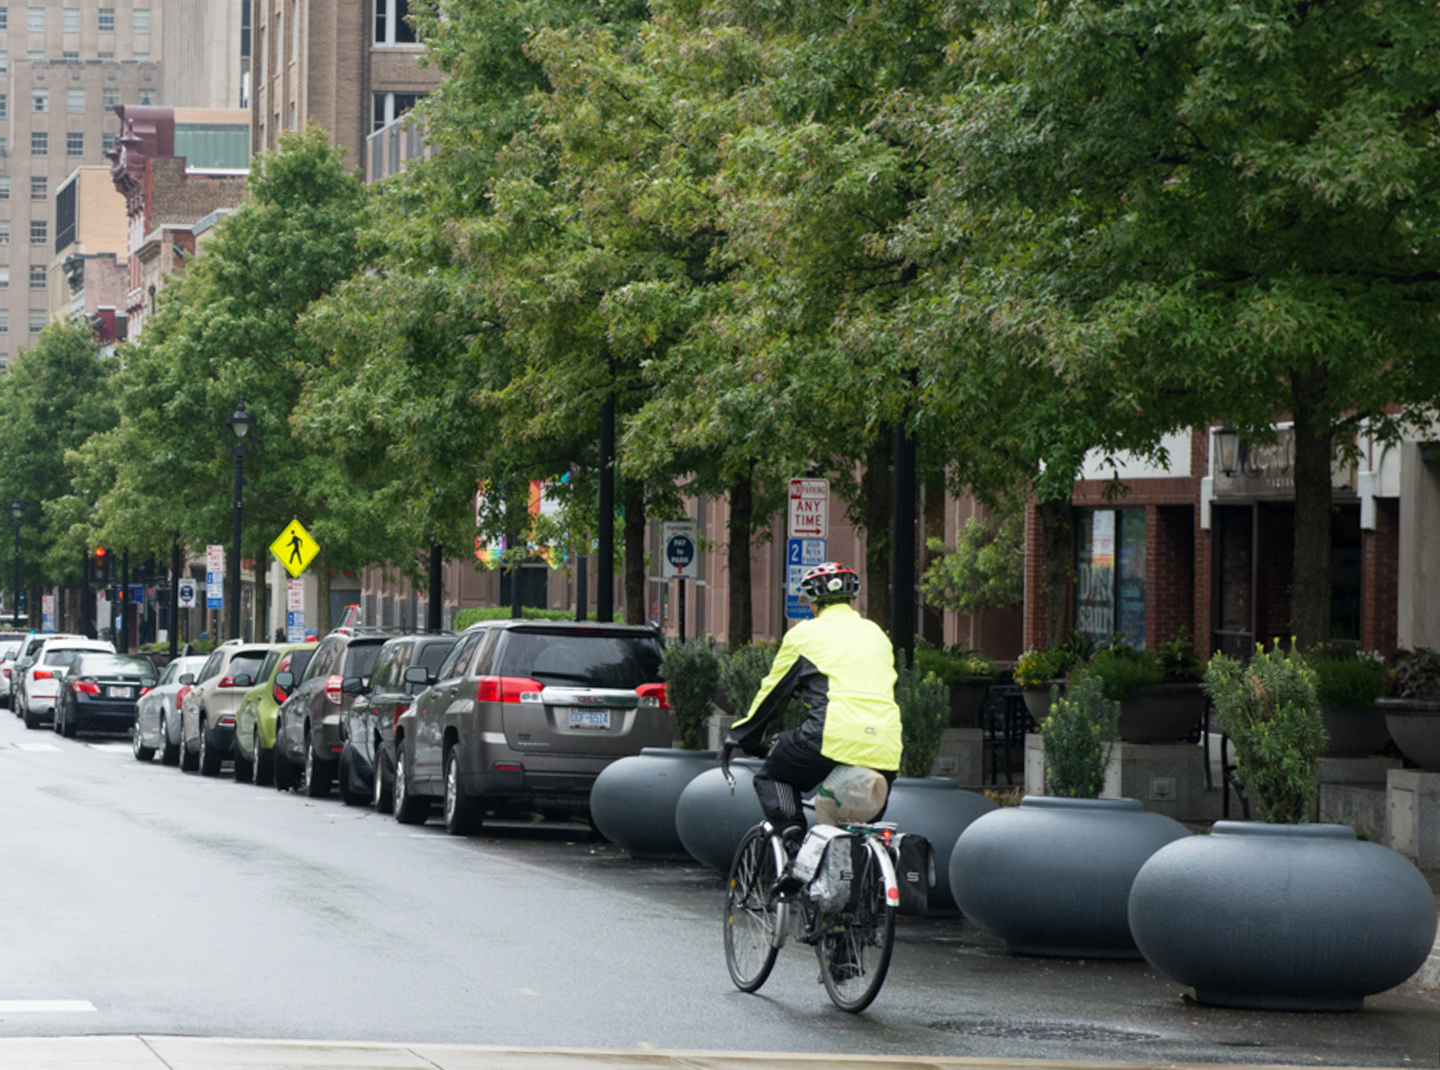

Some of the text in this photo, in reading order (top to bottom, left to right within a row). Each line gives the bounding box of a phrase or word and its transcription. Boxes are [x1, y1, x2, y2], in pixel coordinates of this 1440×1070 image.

[796, 500, 821, 512] ANY
[795, 514, 822, 526] TIME
[791, 543, 800, 562] 2
[578, 695, 604, 703] GMC
